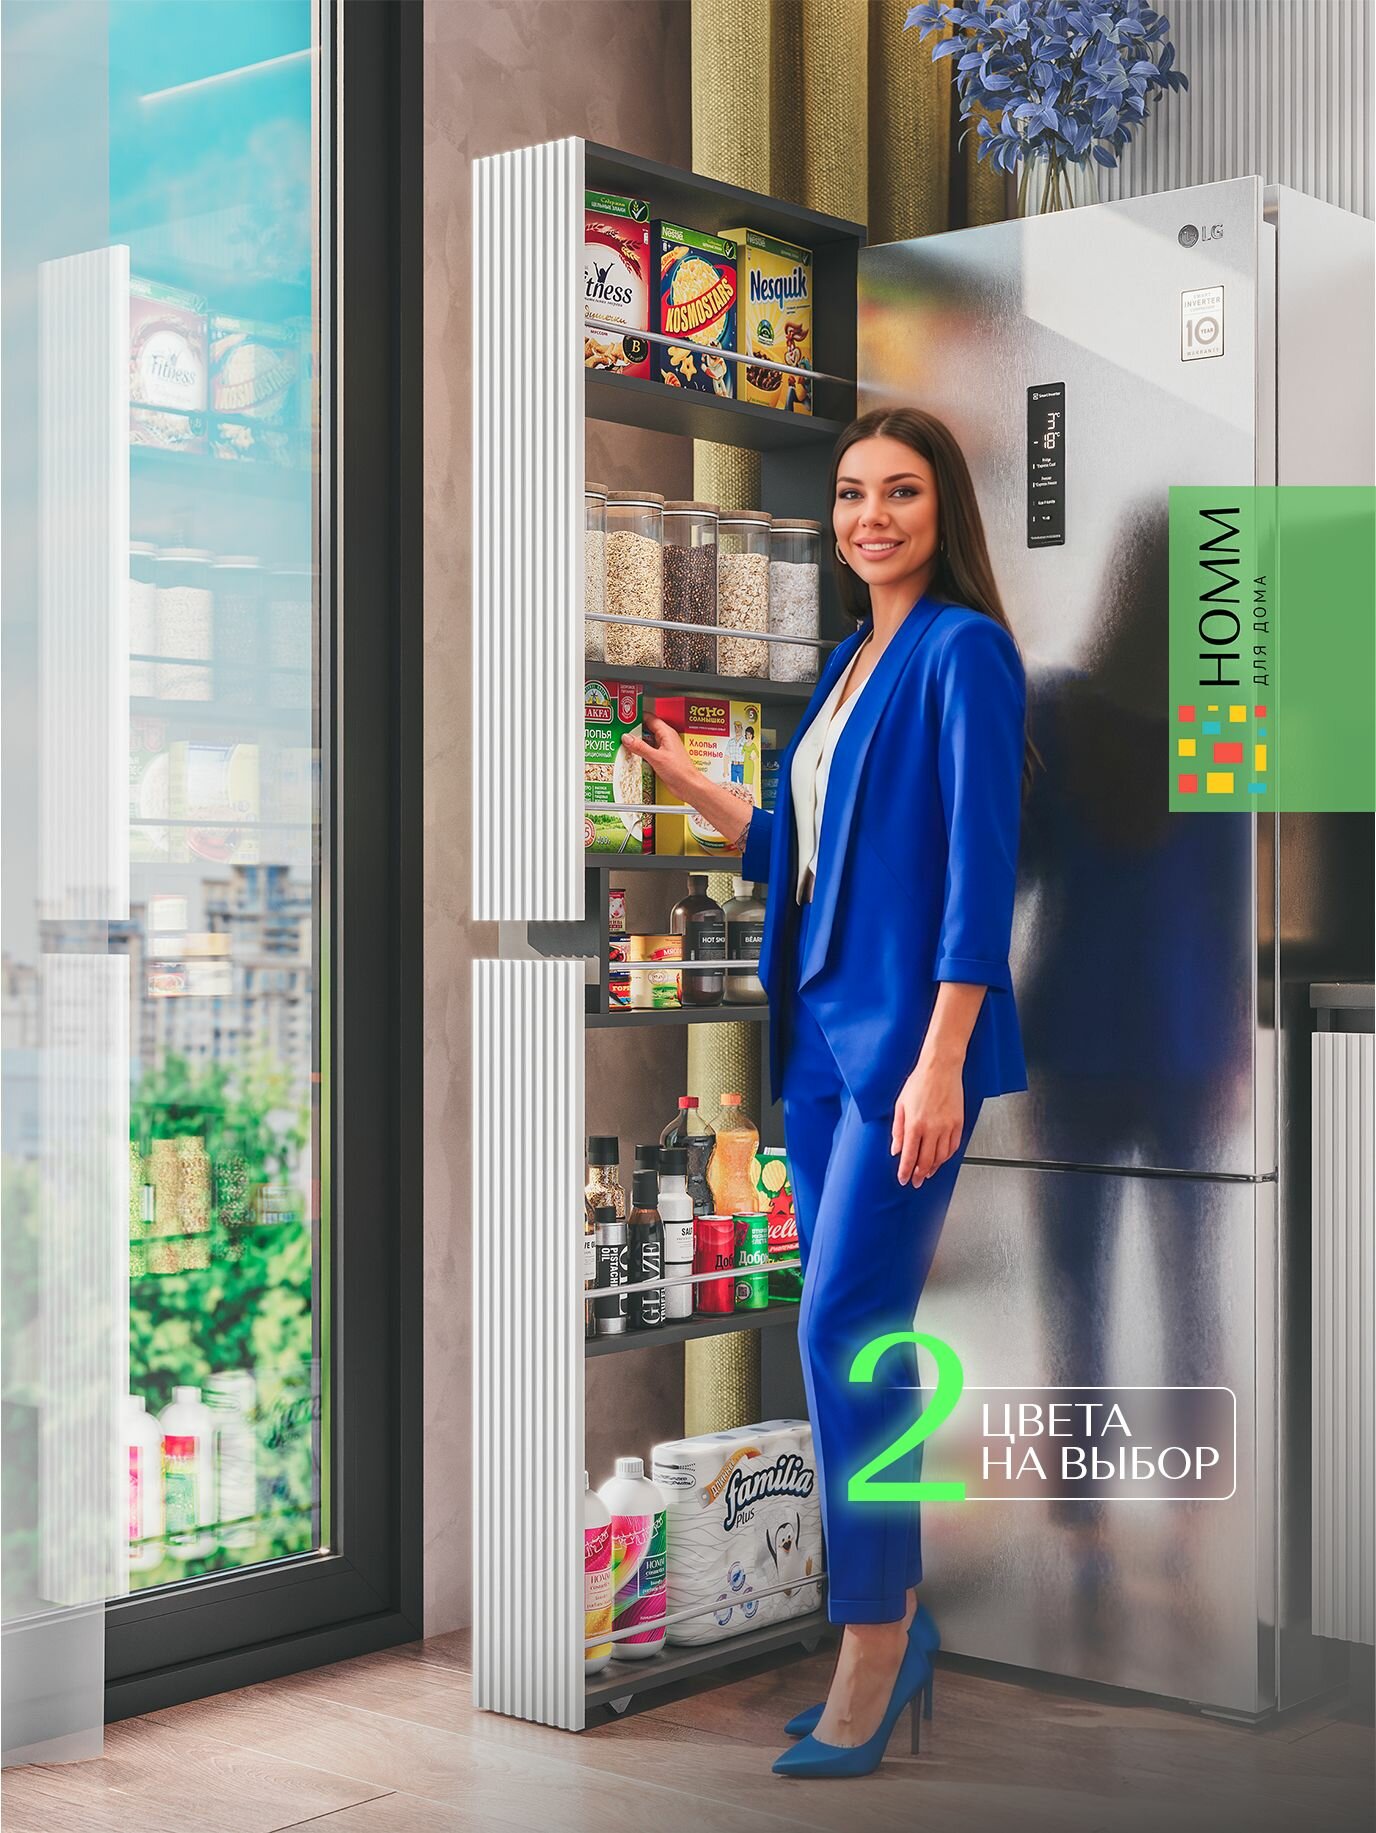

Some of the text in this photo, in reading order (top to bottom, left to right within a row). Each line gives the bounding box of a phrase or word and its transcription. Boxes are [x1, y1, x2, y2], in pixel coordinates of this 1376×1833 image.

[1201, 224, 1224, 241] LG
[749, 265, 808, 311] Nesquik
[665, 277, 734, 334] KOSMOSTARS
[1184, 296, 1221, 308] INVERTER
[1186, 316, 1220, 347] 10
[689, 705, 725, 717] ЯСНО
[689, 716, 725, 724] СОЛНЫШКО
[585, 729, 612, 739] ЛОПЬЯ
[585, 740, 615, 751] РКУЛЕС
[601, 1247, 610, 1262] OIL
[715, 1254, 734, 1270] Доб
[610, 1247, 619, 1287] PISTACHI
[723, 1454, 815, 1531] familia
